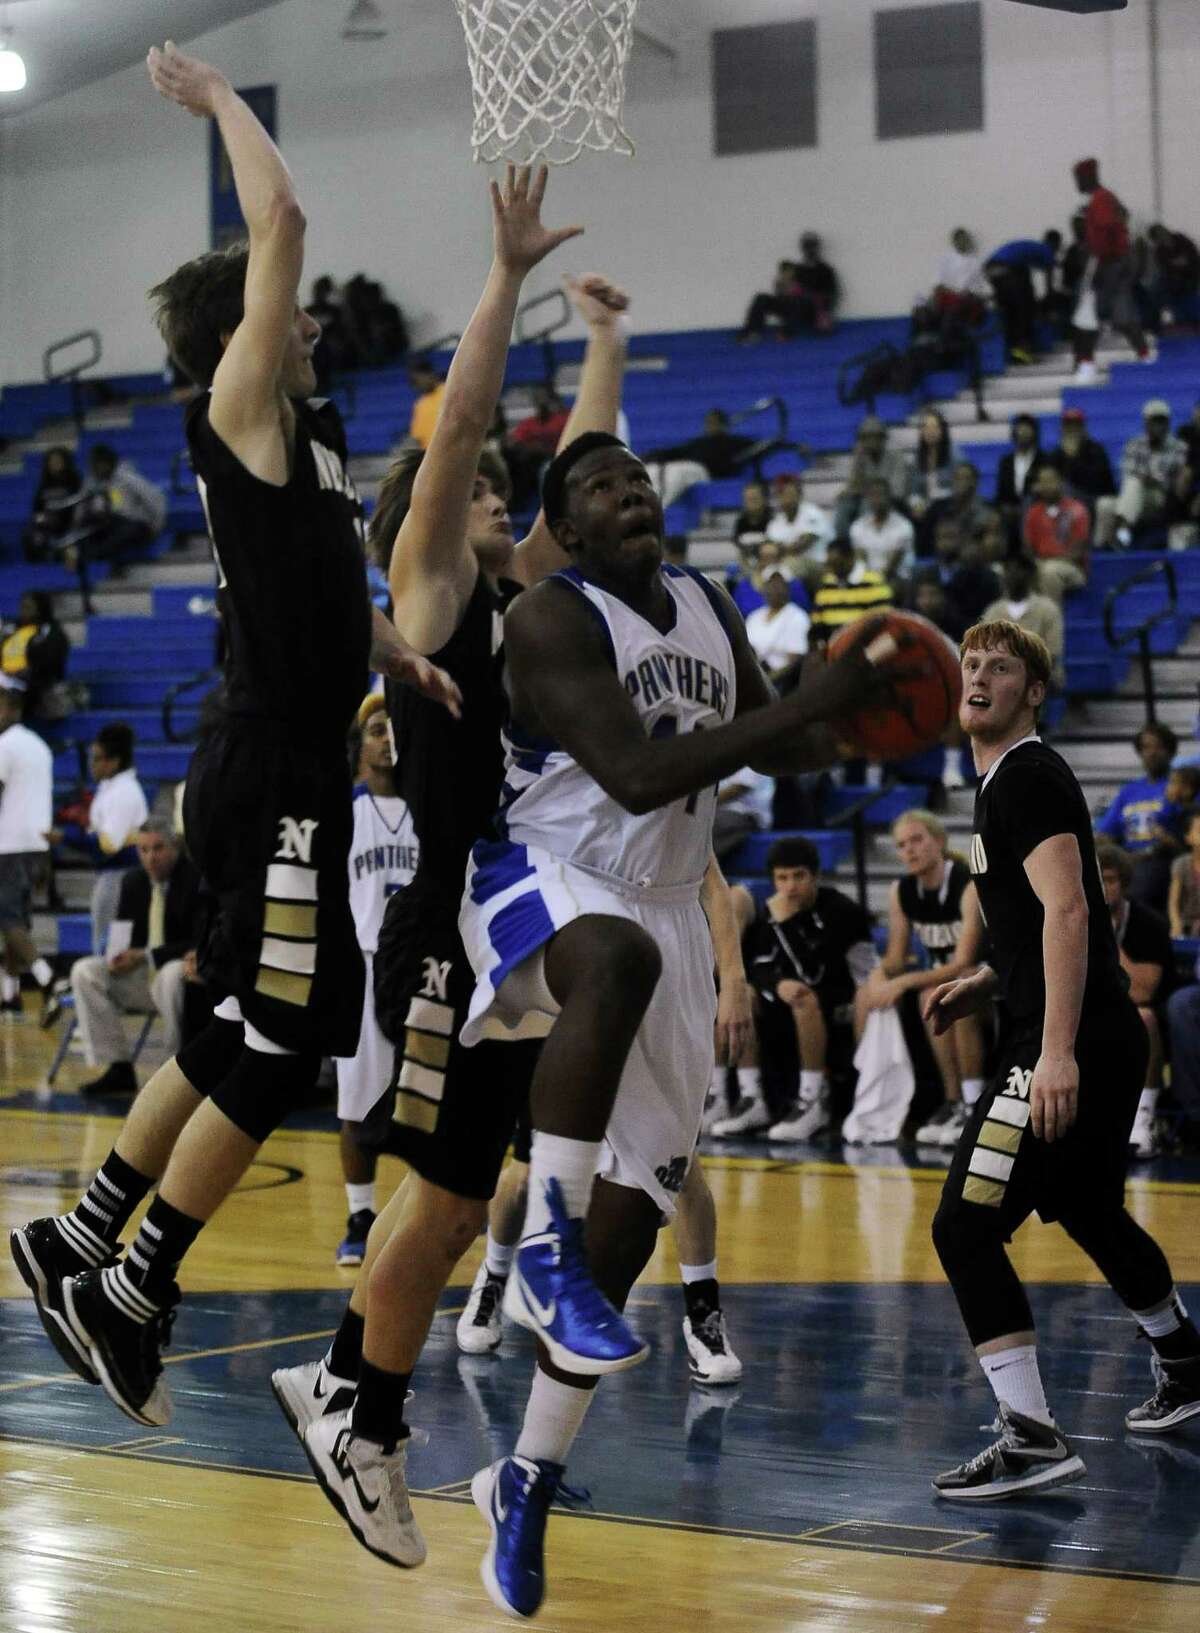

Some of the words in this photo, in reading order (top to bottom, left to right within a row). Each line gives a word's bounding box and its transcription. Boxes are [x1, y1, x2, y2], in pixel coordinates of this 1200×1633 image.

[274, 815, 320, 863] N
[416, 956, 453, 1001] N
[1001, 1065, 1033, 1099] N
